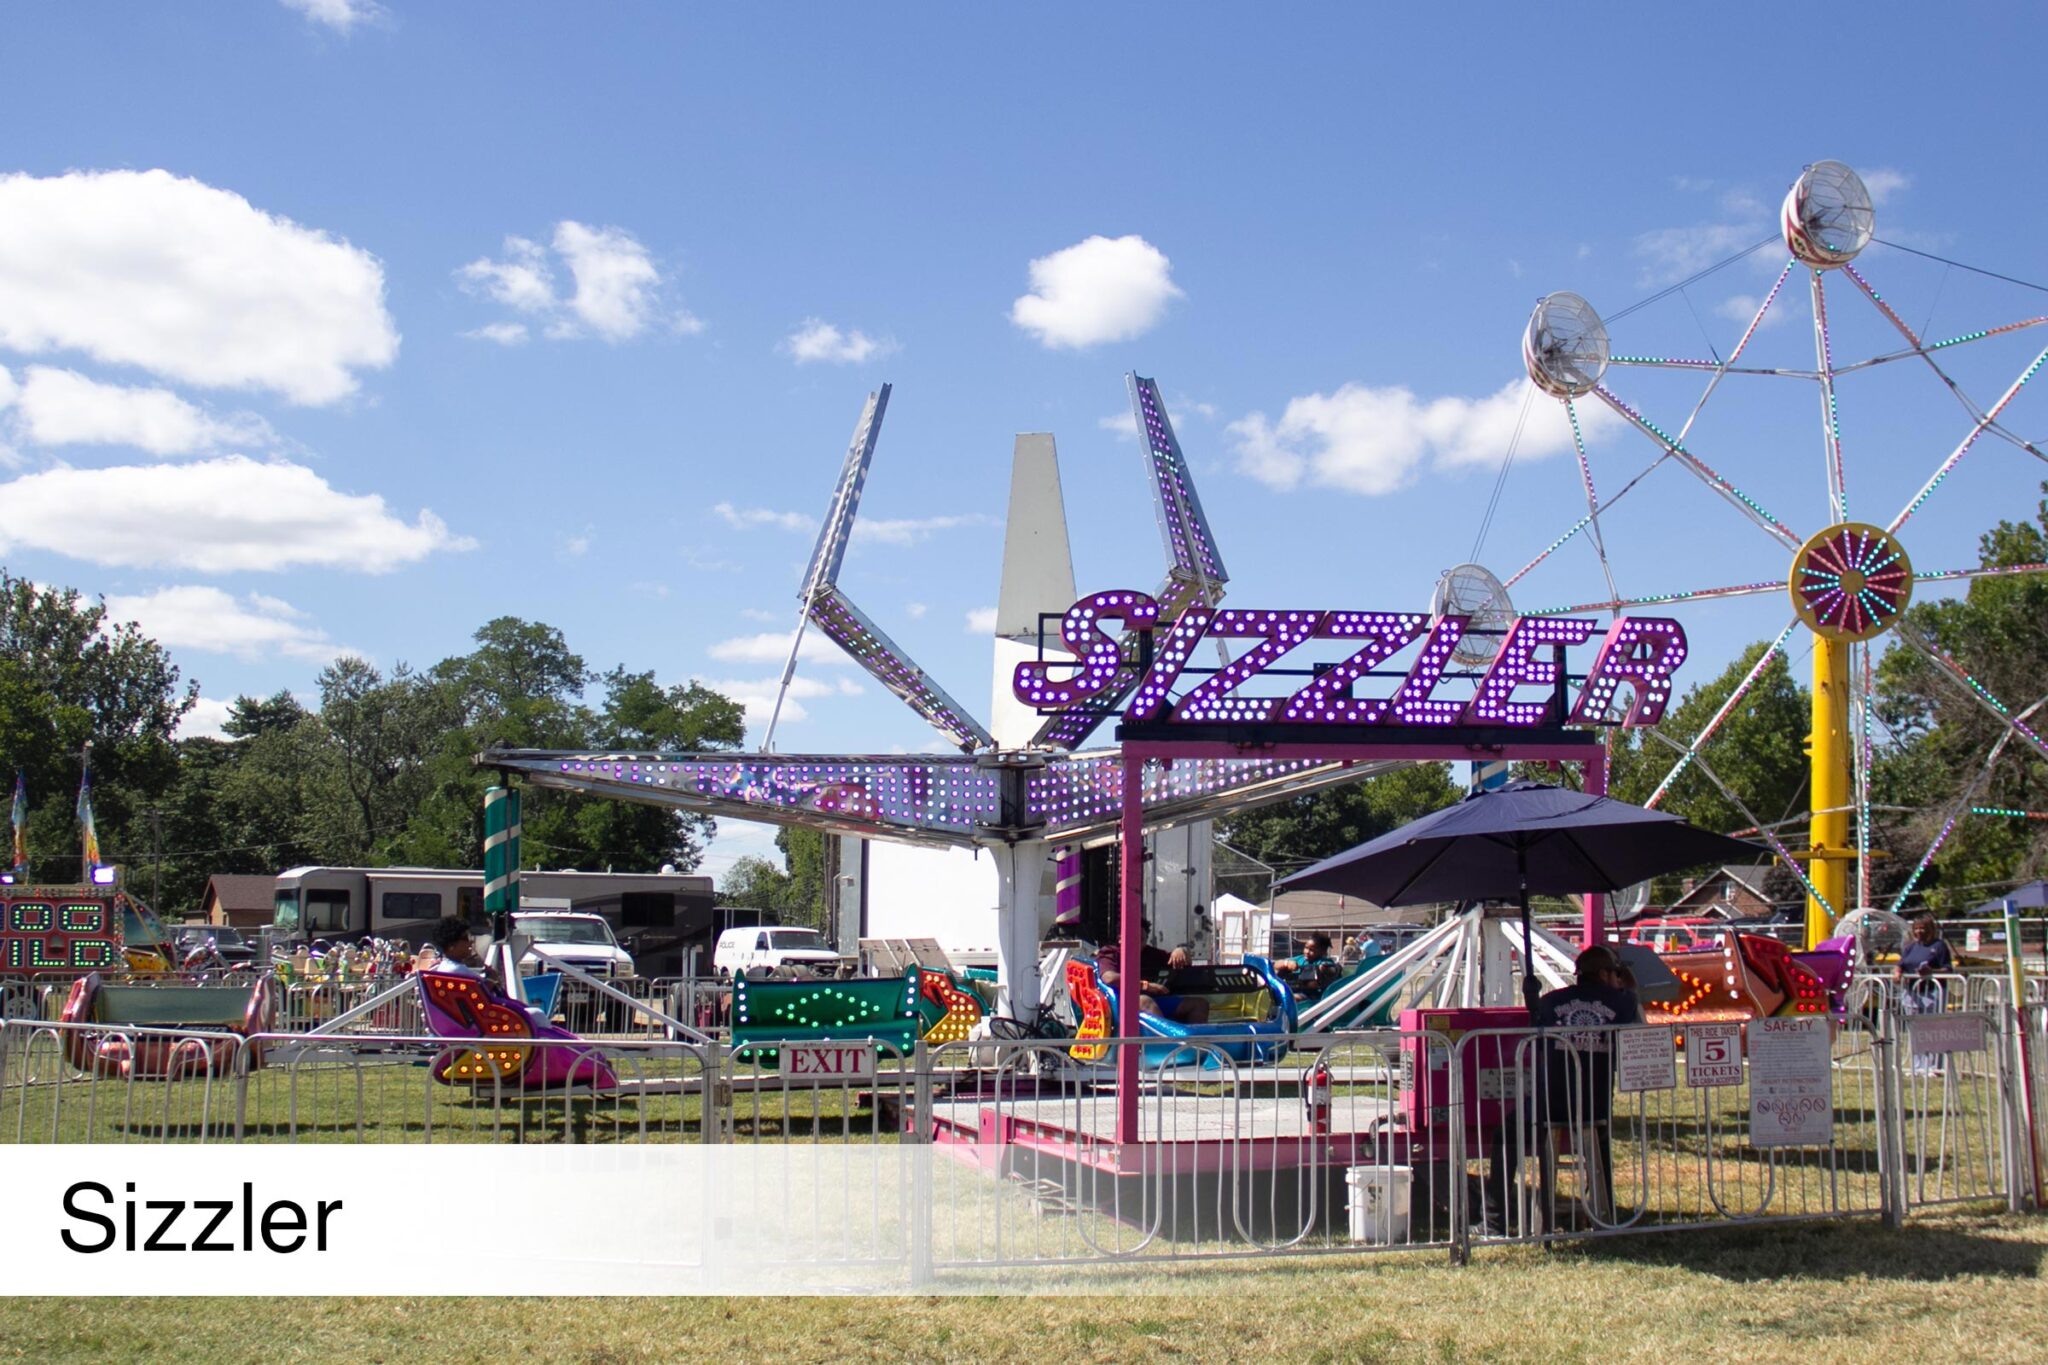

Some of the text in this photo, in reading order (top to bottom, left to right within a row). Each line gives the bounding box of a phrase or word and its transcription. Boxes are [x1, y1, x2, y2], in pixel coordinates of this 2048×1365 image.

[1013, 589, 1687, 727] SIZZLER
[0, 902, 104, 933] OG
[0, 938, 115, 968] ILD
[719, 941, 735, 949] POLICE
[1690, 1026, 1738, 1037] THIS RIDE TAKES
[1917, 1027, 1979, 1043] ENTRANCE
[790, 1048, 867, 1073] EXIT
[1705, 1040, 1725, 1061] 5
[1690, 1066, 1740, 1077] TICKETS
